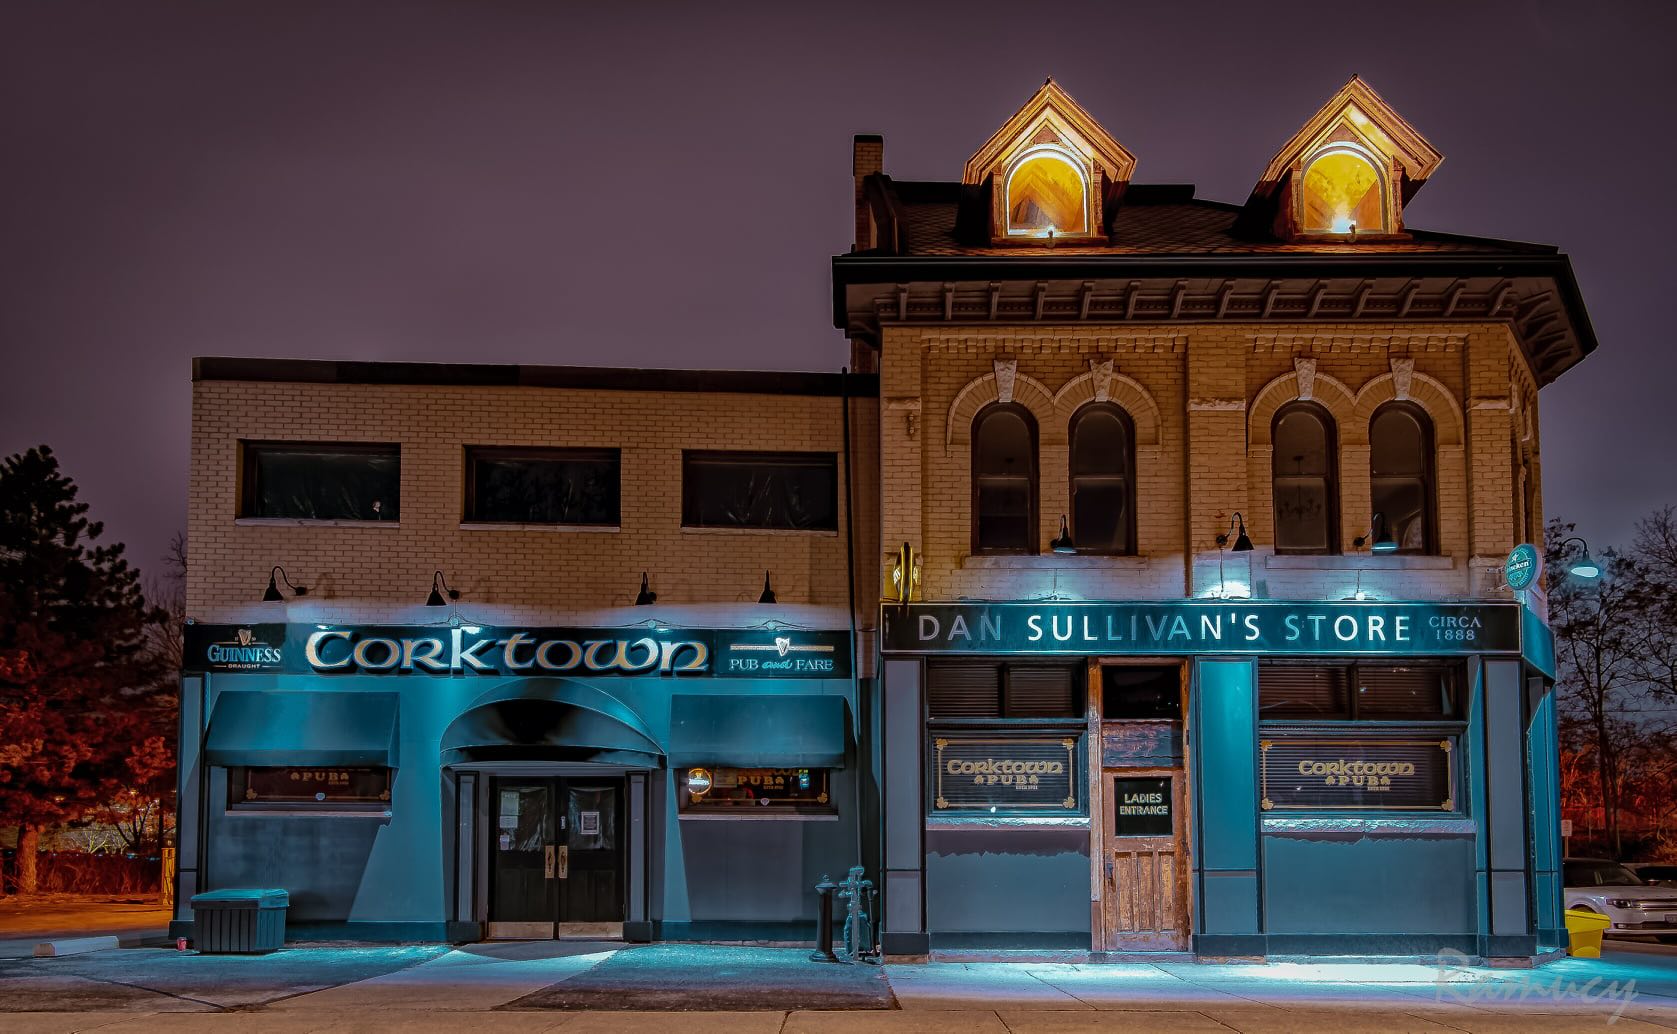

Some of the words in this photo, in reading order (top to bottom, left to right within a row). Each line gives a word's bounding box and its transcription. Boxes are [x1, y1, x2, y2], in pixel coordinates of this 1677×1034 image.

[1429, 615, 1482, 628] CIRCA
[918, 614, 1001, 641] DAN
[1027, 614, 1260, 641] SULLIVAN'S
[1285, 614, 1411, 642] STORE
[1435, 628, 1477, 641] 1888
[207, 644, 281, 662] GUINNESS
[729, 659, 759, 670] PUB
[762, 659, 793, 669] and
[796, 659, 834, 671] FARE
[301, 771, 339, 781] PUB
[736, 776, 774, 785] PUB
[987, 774, 1028, 785] PUB
[1338, 775, 1380, 786] PUB
[1124, 793, 1163, 804] LADIES
[1120, 805, 1168, 815] ENTRANCE
